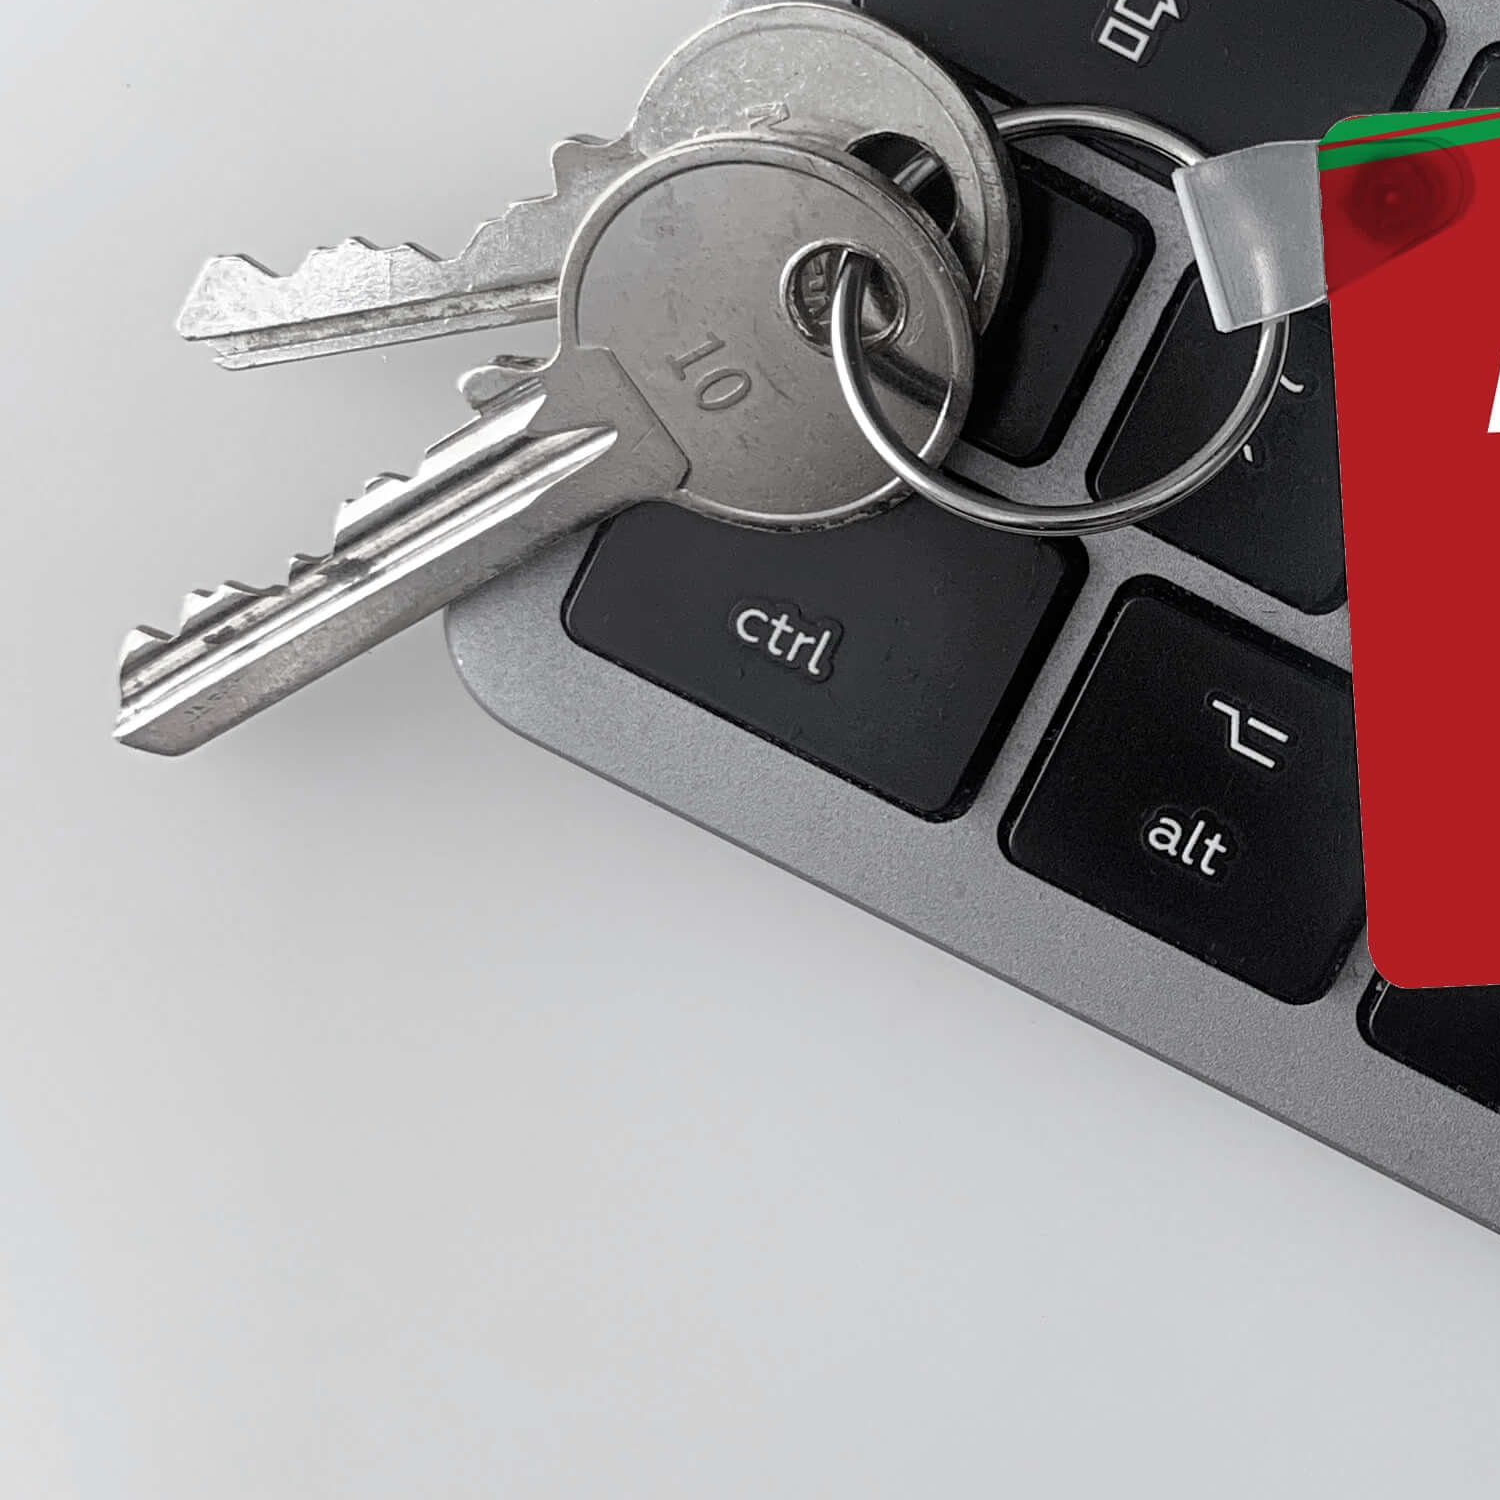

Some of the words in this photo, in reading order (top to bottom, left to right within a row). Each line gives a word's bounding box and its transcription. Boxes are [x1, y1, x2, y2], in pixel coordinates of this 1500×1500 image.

[664, 331, 752, 411] 10
[736, 608, 832, 675] ctrl
[1148, 816, 1227, 876] alt
